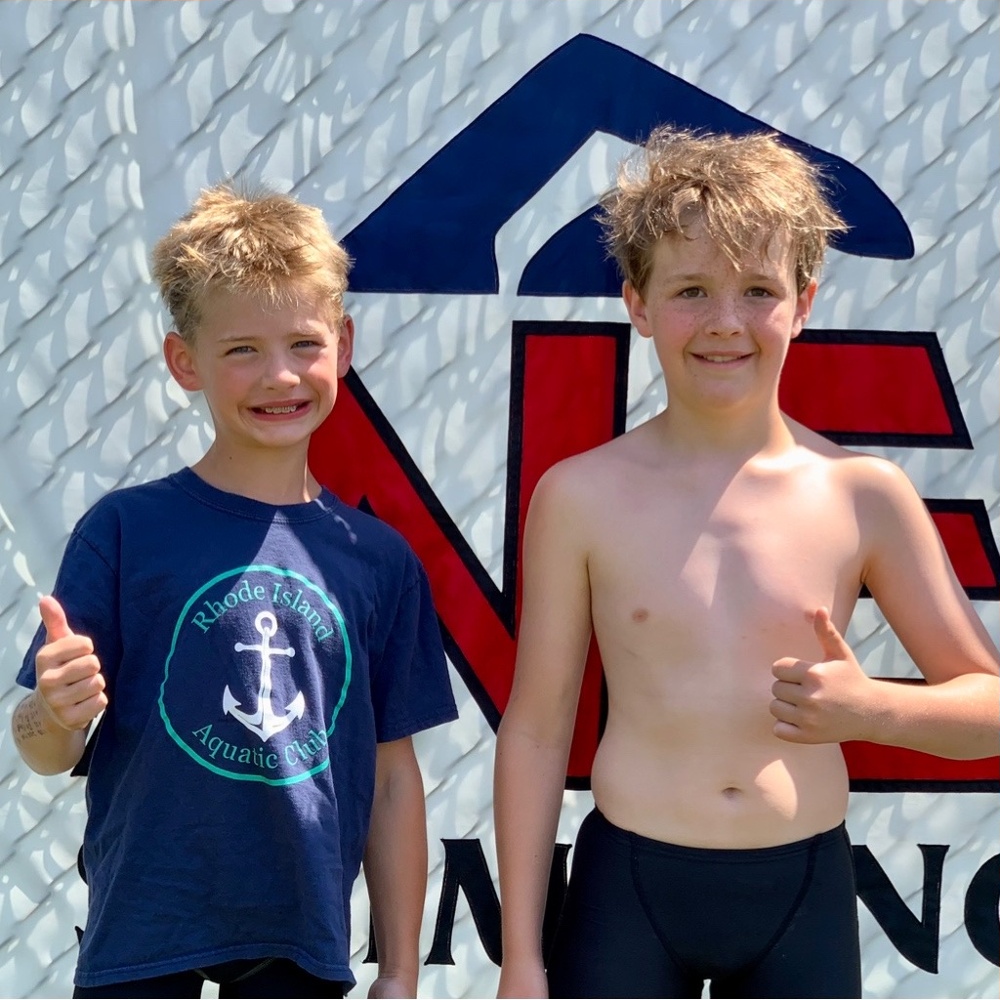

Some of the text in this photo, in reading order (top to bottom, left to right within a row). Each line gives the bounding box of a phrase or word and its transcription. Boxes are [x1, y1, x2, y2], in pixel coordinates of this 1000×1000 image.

[191, 579, 334, 642] Rhode Island
[191, 723, 328, 769] Aquatic Club
